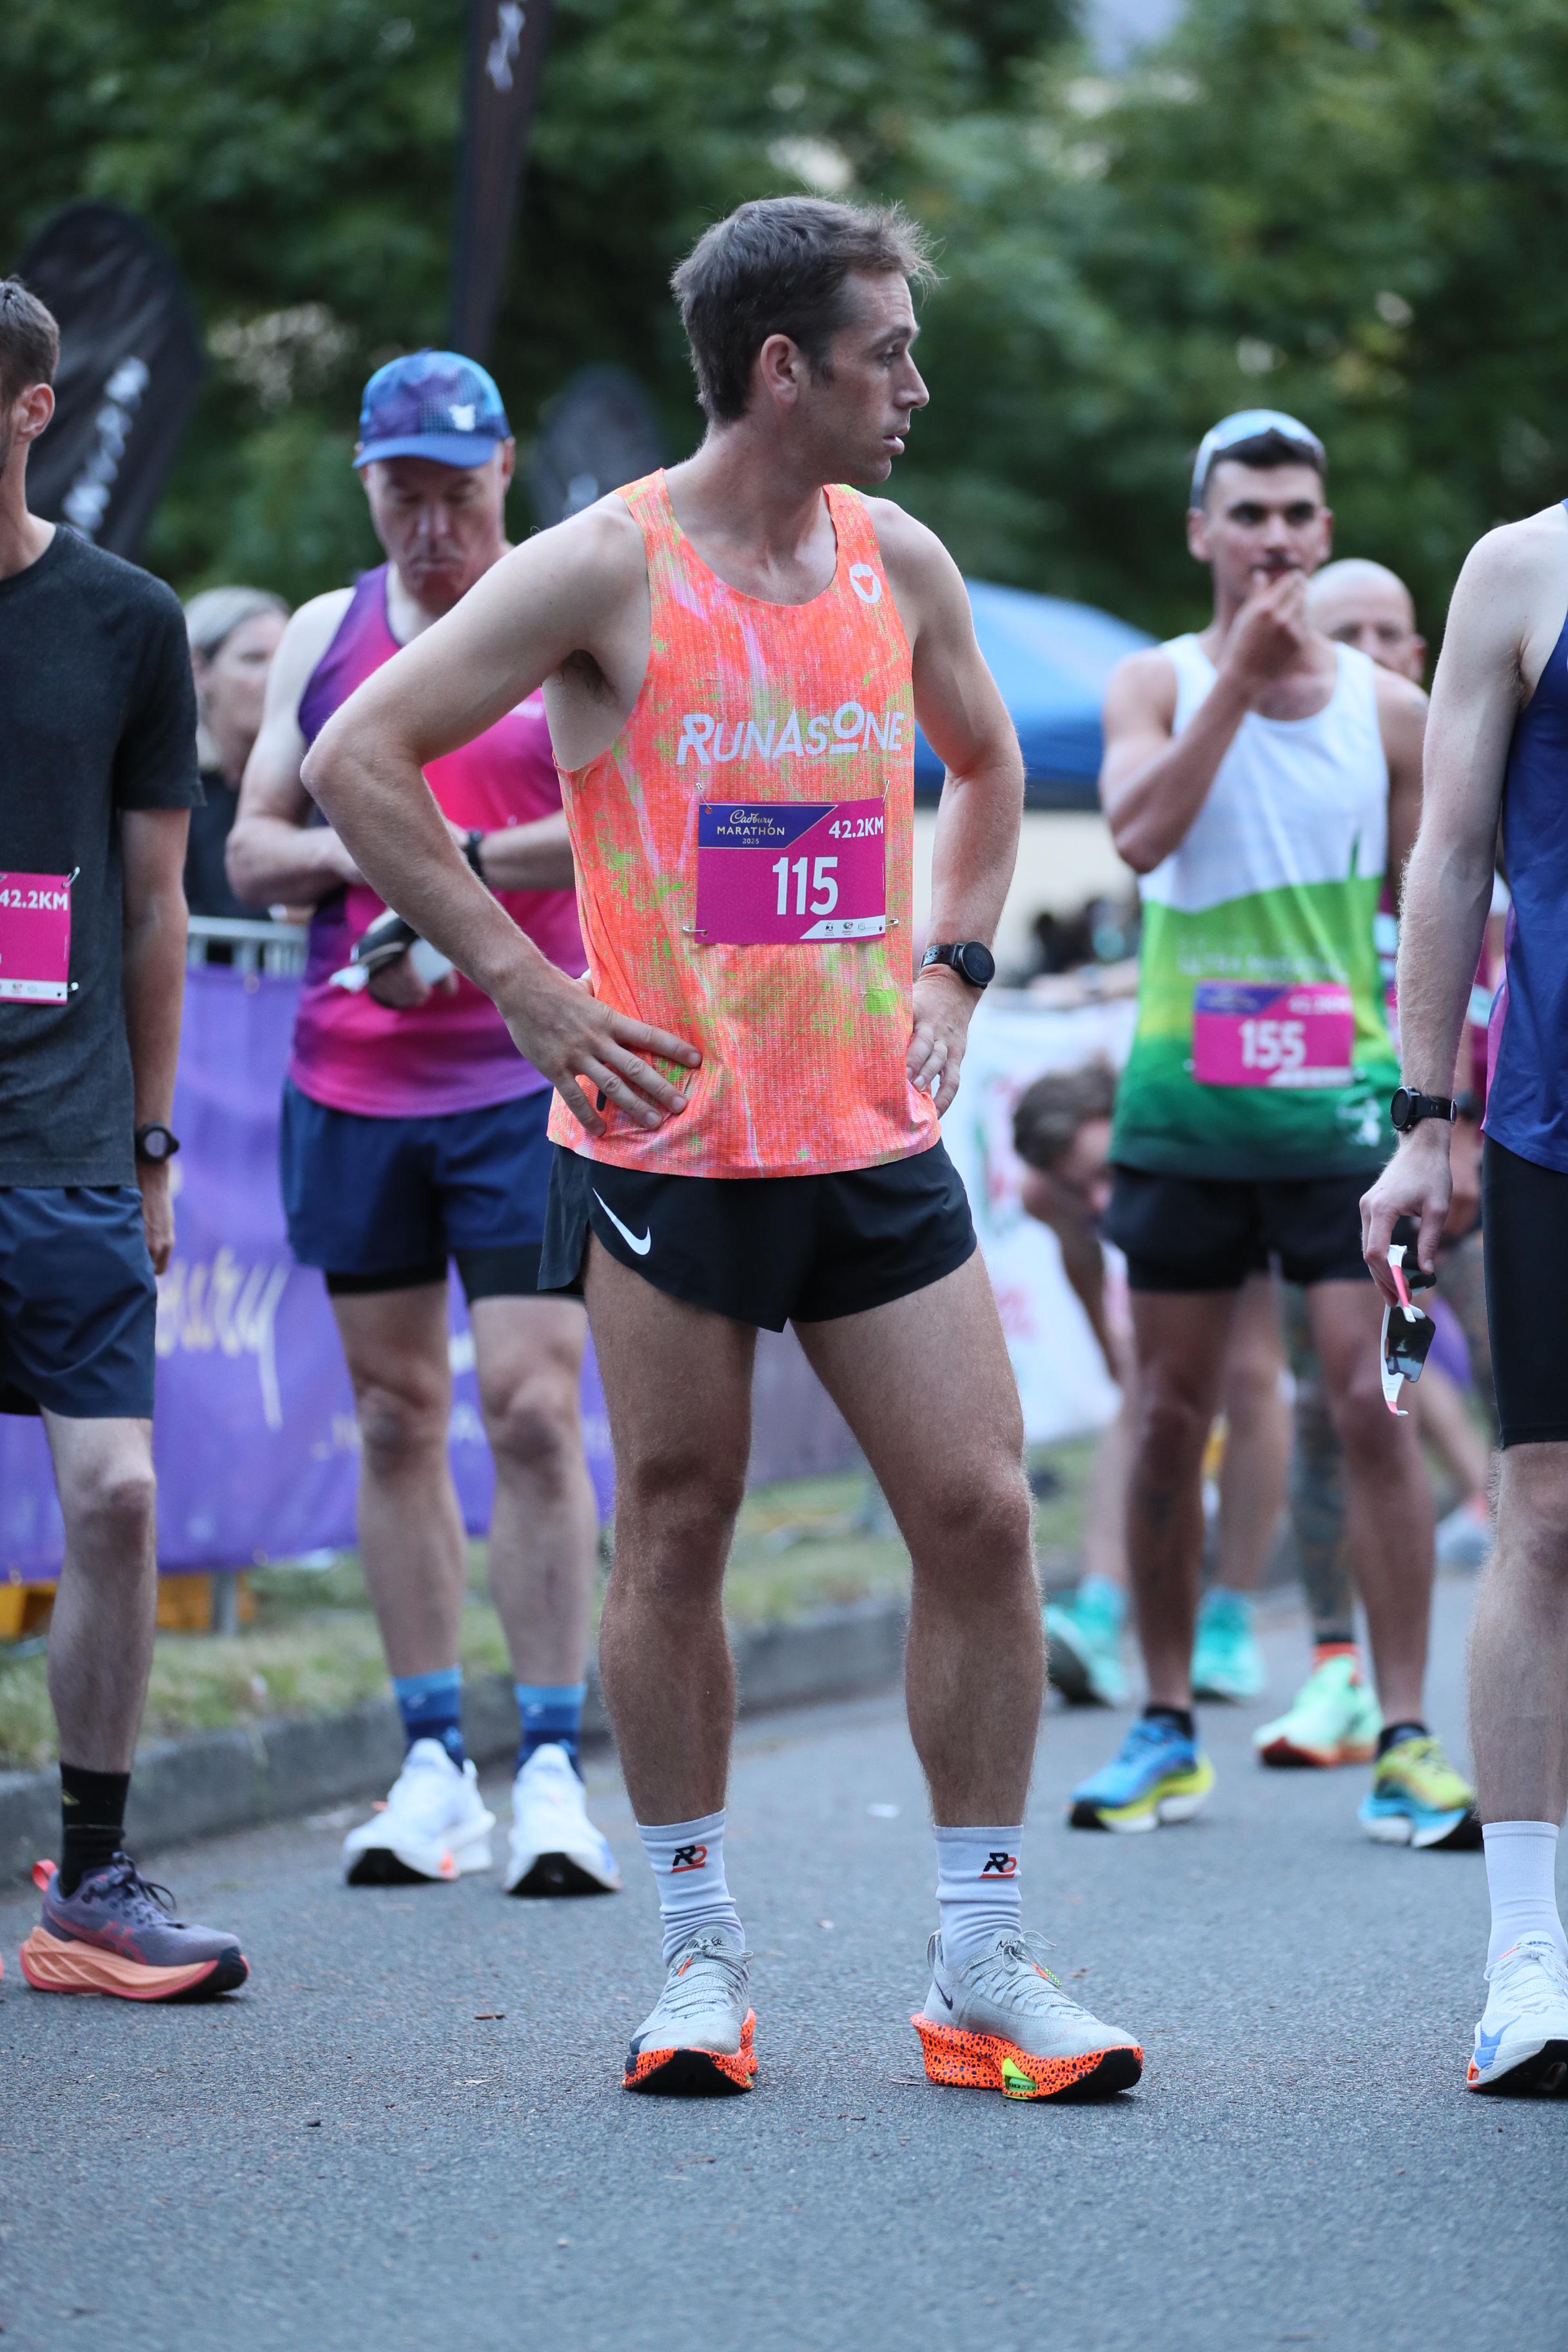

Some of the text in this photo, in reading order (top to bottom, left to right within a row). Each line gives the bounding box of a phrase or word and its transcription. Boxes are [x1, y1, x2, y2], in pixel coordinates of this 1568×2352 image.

[729, 809, 773, 827] Cadbury
[828, 816, 884, 839] 42.2KM
[716, 826, 785, 836] MARATHON
[772, 856, 838, 915] 115
[1239, 1020, 1306, 1068] 155
